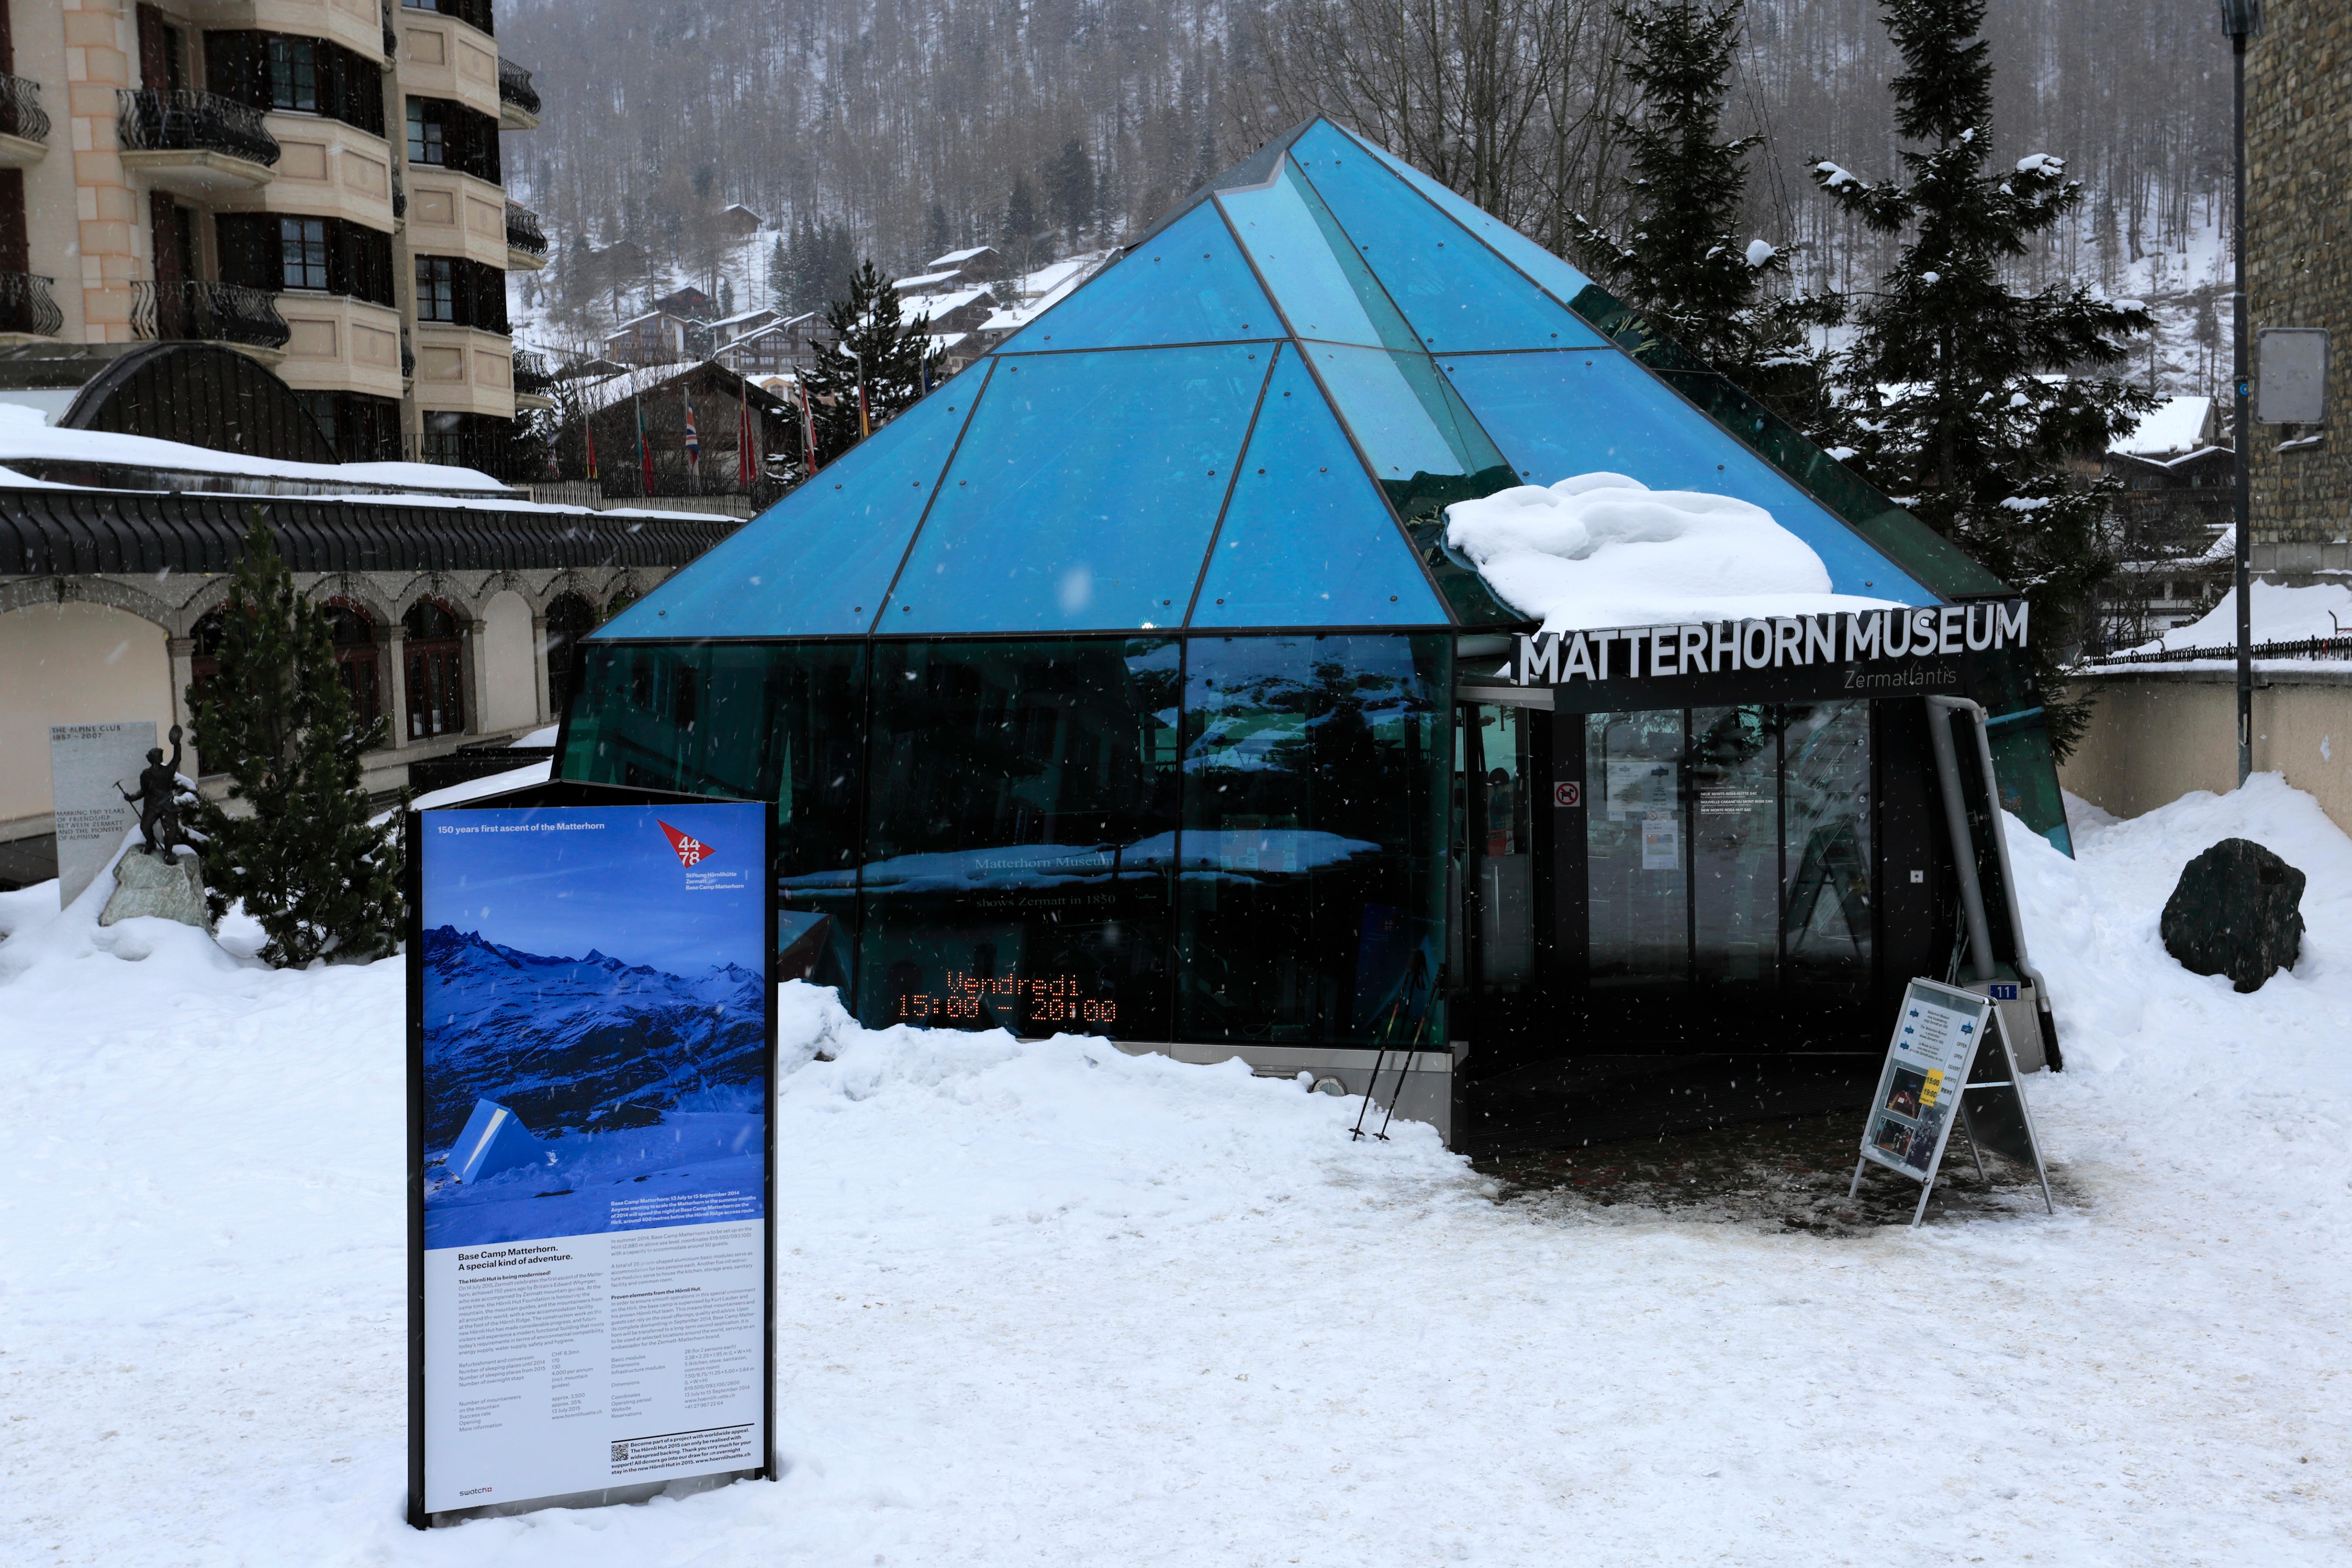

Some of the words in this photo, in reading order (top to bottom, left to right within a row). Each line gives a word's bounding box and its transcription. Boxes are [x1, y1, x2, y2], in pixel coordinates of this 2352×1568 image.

[1518, 614, 1836, 686] MATTERHORN
[1845, 601, 2029, 662] MUSEUM
[1844, 667, 1957, 689] Zermatlantis
[678, 836, 700, 851] 44
[679, 852, 700, 866] 78
[975, 858, 1050, 869] Matterhorn
[1056, 857, 1114, 867] Museum
[977, 898, 1014, 907] shows
[1018, 897, 1066, 906] Zermatt
[1071, 895, 1081, 905] in
[1087, 895, 1116, 904] 1850
[947, 971, 1079, 996] Vendredi
[1997, 987, 2009, 998] 11
[899, 995, 978, 1018] 15:00
[1032, 998, 1116, 1022] 20:00
[1926, 1077, 1940, 1086] 15:00
[508, 1246, 558, 1256] Matterhorn.
[466, 1260, 497, 1271] special
[498, 1258, 516, 1266] kind
[528, 1254, 572, 1263] adventure.
[552, 1409, 603, 1420] www.hoernlihuette.ch
[460, 1487, 487, 1496] swatch
